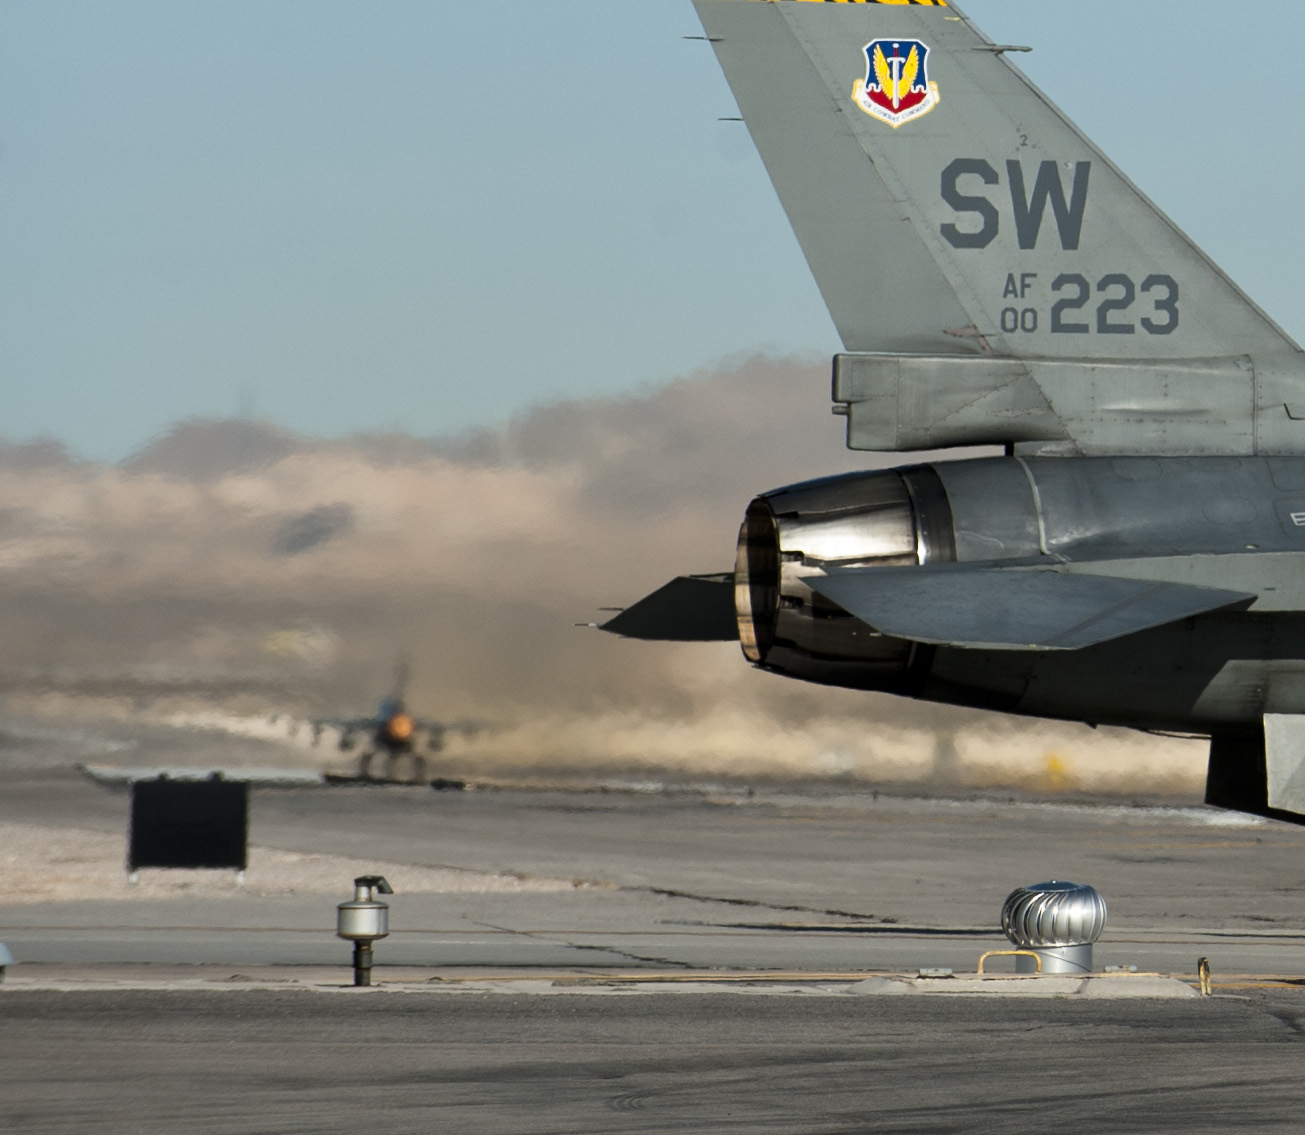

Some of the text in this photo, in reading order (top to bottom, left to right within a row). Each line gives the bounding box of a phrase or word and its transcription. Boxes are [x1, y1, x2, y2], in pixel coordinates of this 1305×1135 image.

[940, 158, 1091, 250] SW
[1002, 273, 1038, 298] AF
[1050, 273, 1179, 335] 223
